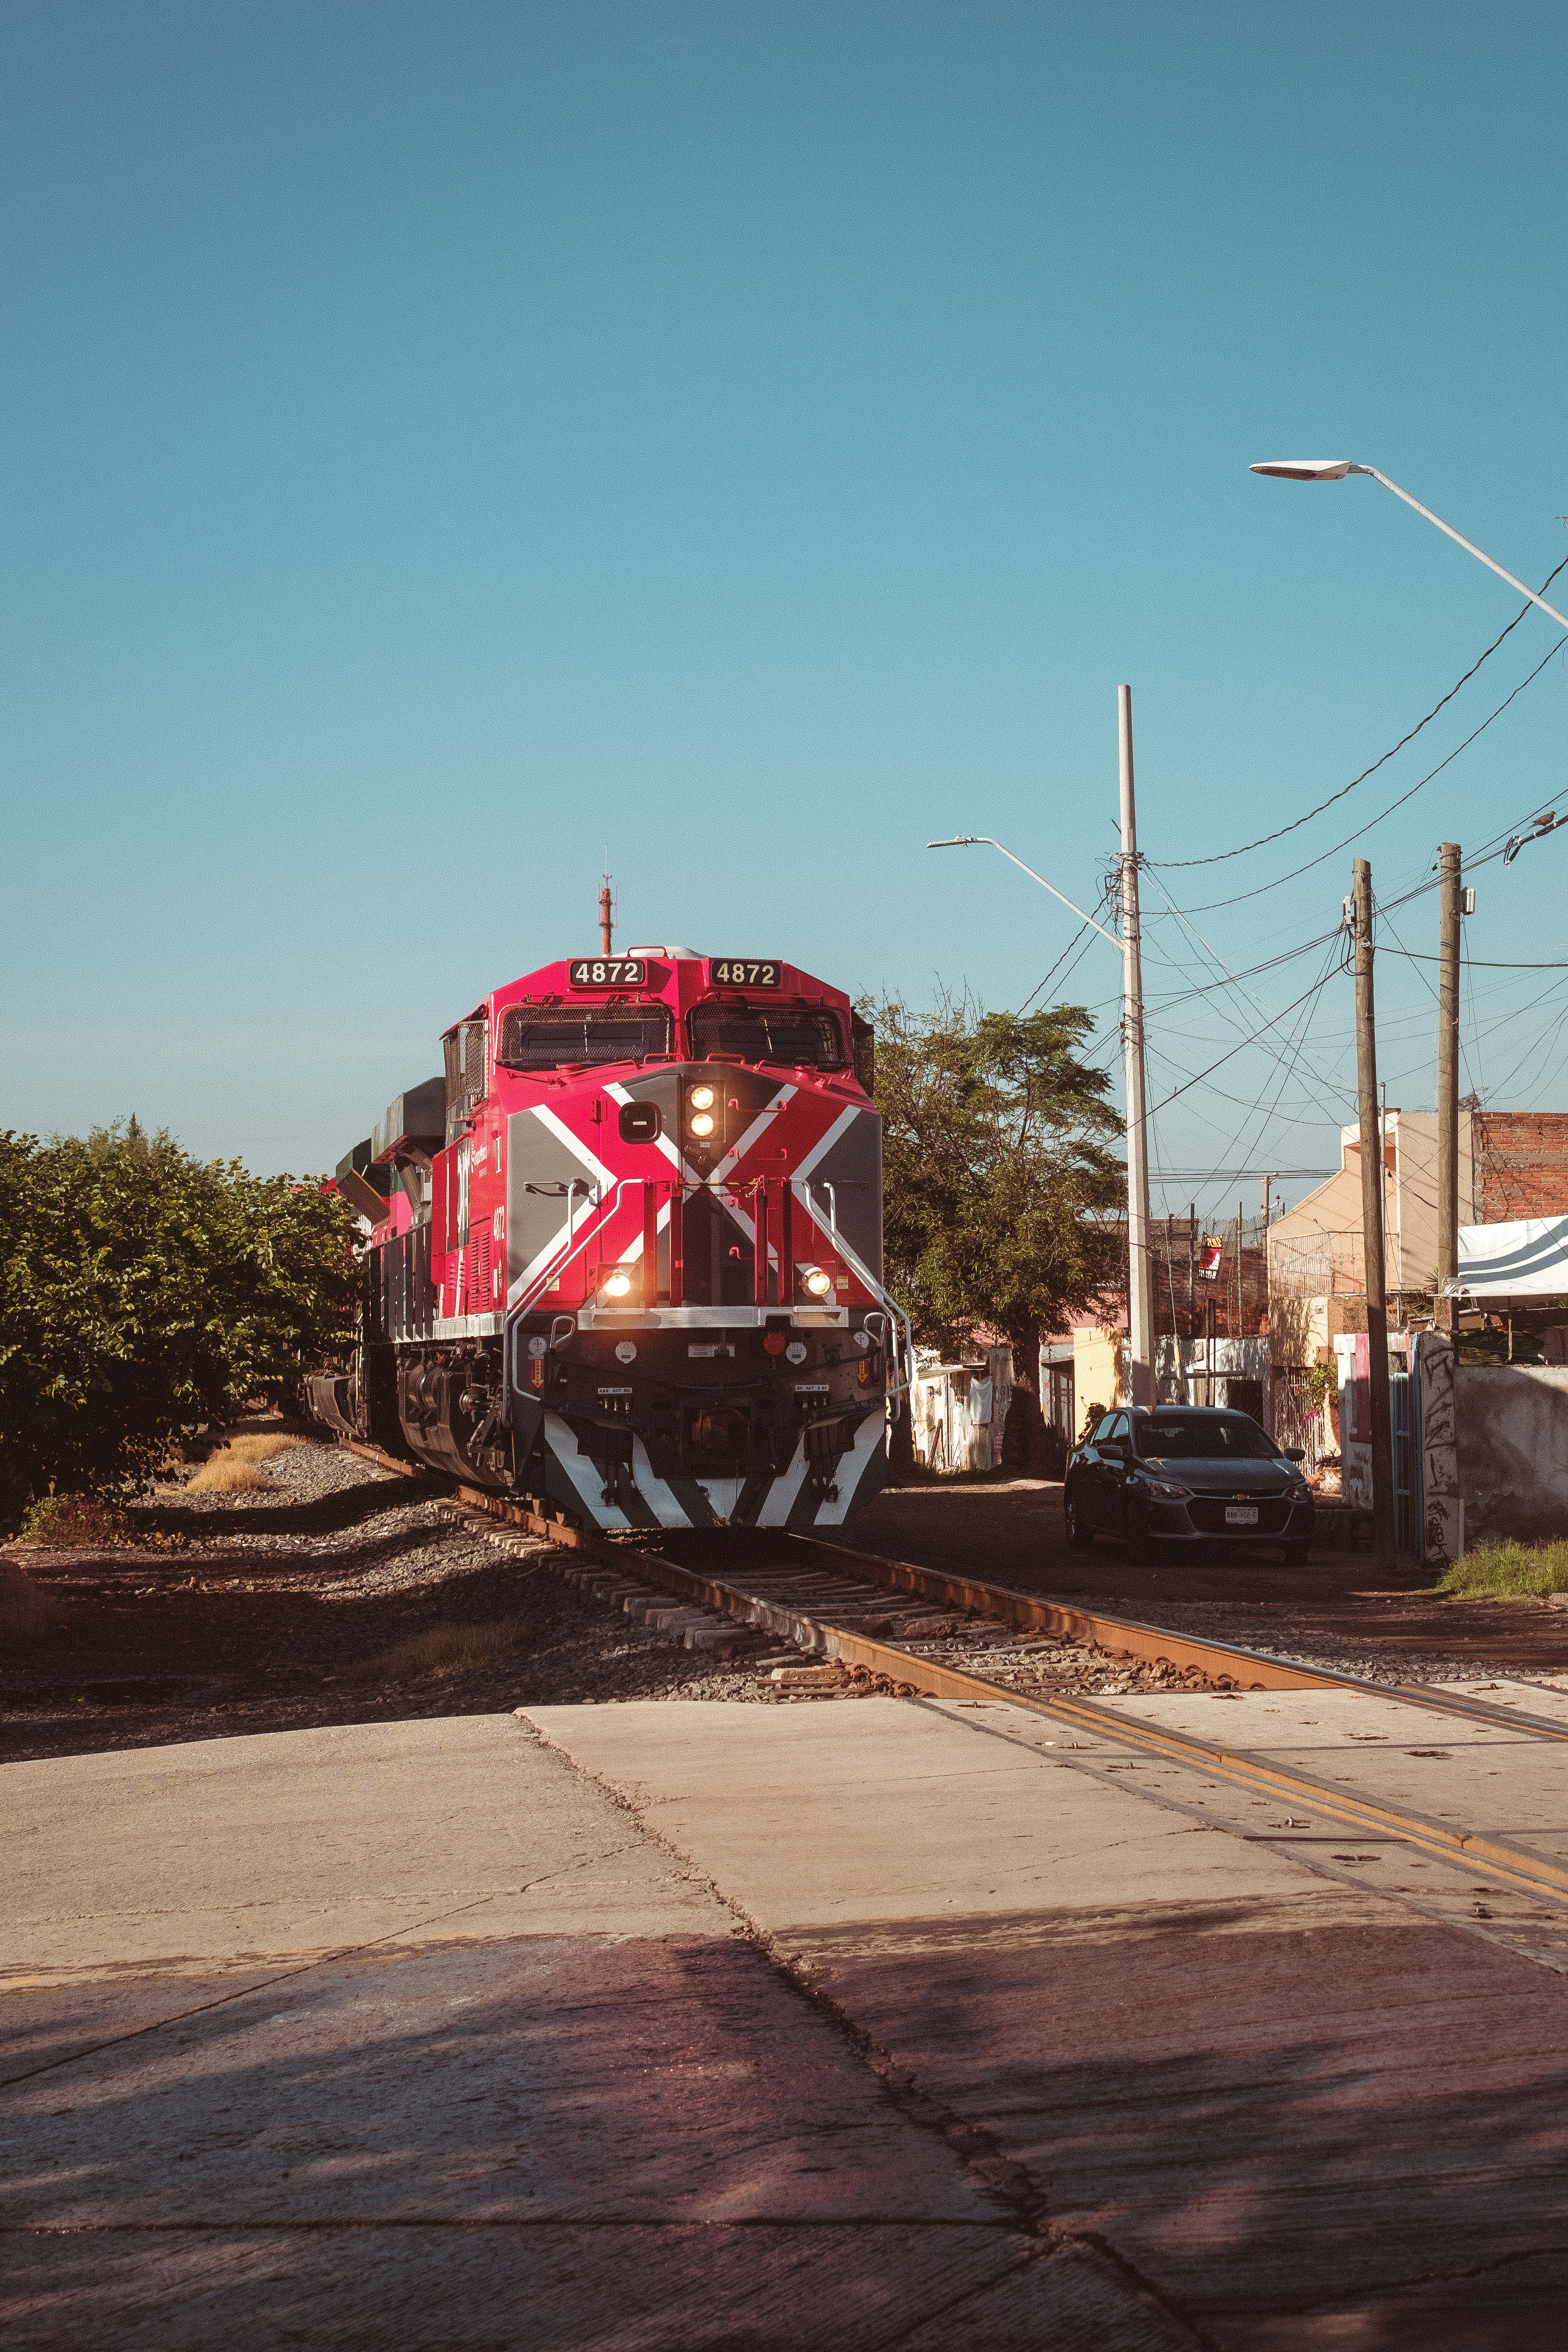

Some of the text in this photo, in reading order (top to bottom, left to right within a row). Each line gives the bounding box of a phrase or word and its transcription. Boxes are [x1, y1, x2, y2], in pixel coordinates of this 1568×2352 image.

[576, 963, 638, 982] 4872
[717, 963, 774, 984] 4872
[493, 1205, 505, 1242] 4872
